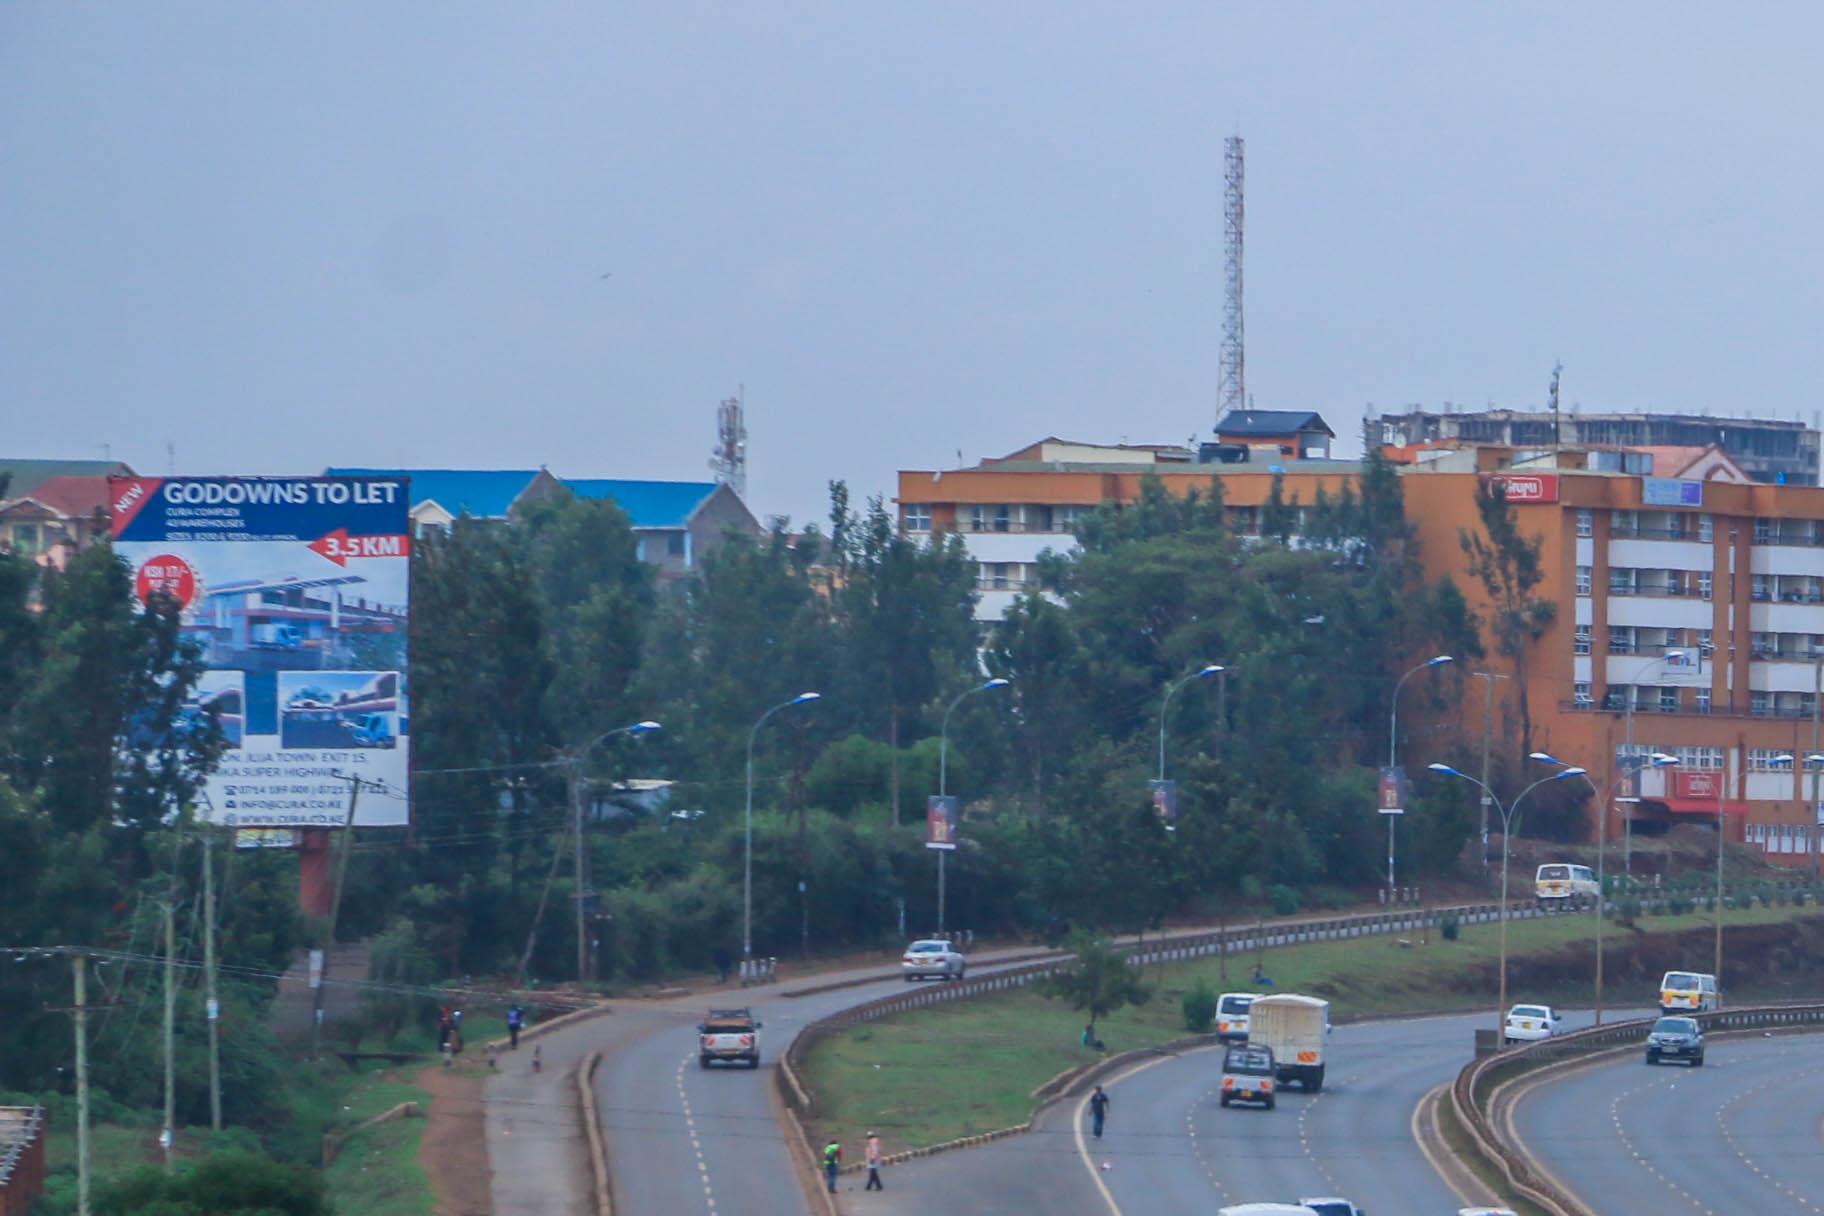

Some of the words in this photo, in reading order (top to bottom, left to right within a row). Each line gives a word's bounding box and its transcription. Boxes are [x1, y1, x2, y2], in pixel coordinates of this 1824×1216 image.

[113, 483, 144, 513] NEW
[164, 482, 309, 504] GODOWNS
[312, 482, 350, 504] TO
[353, 482, 400, 504] LET
